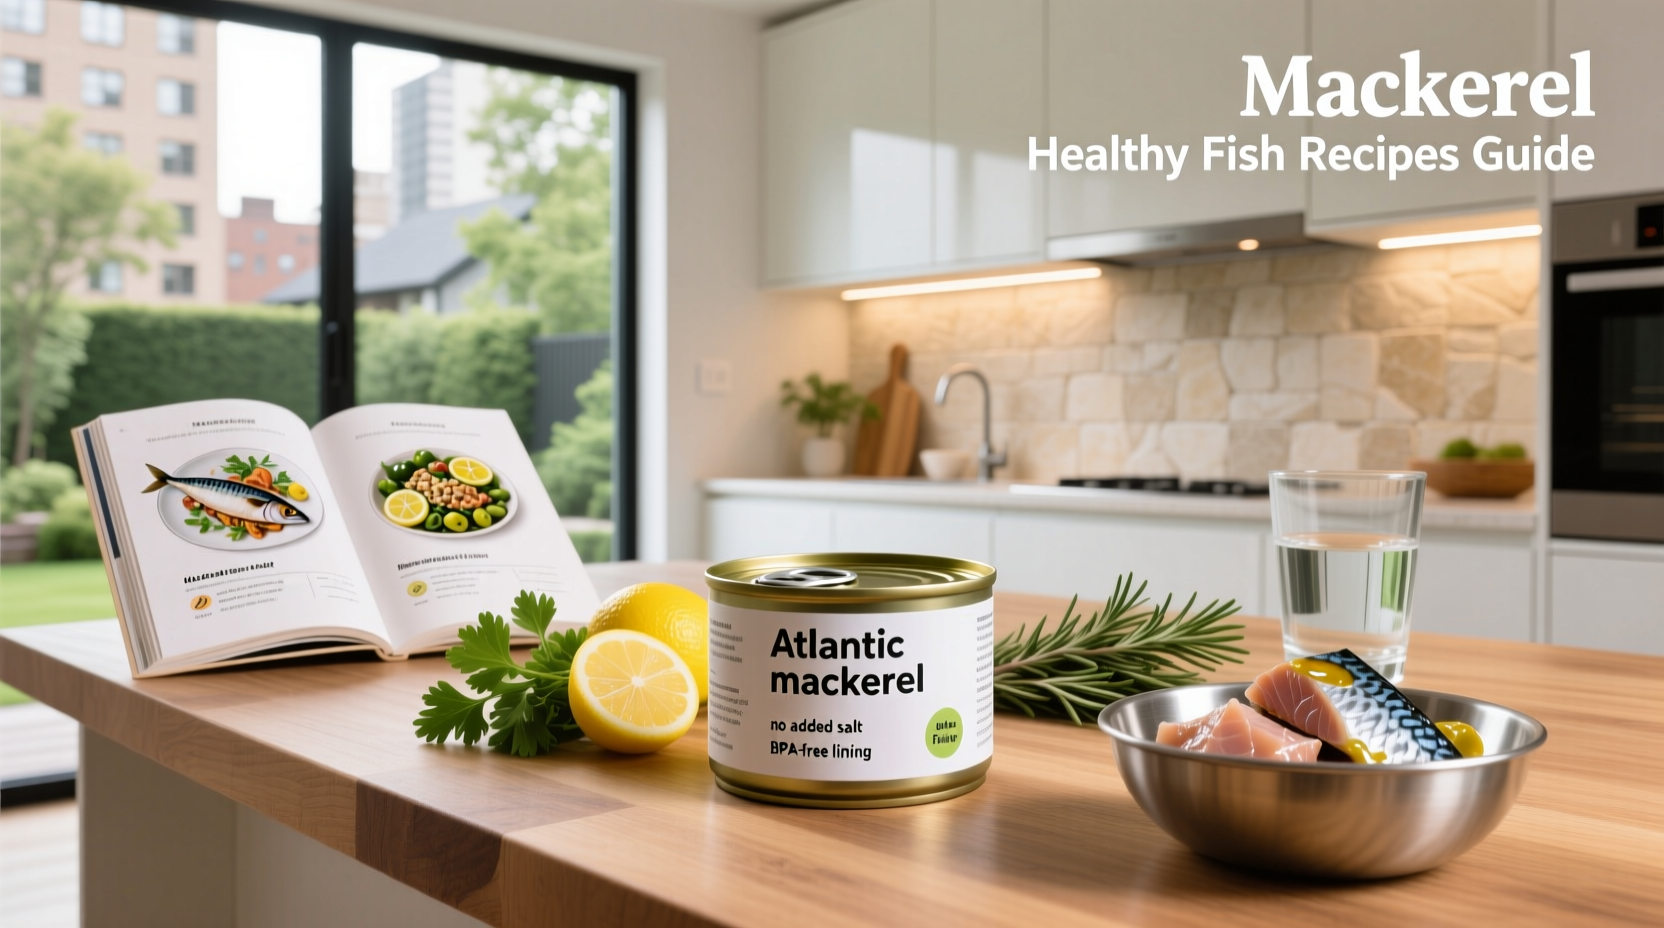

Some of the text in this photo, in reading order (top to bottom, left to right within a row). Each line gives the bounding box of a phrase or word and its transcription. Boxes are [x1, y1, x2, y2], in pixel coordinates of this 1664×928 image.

[770, 628, 905, 659] Atlantic
[770, 663, 924, 696] mackerel
[770, 719, 863, 733] no added salt
[770, 741, 872, 761] BPA-free lining
